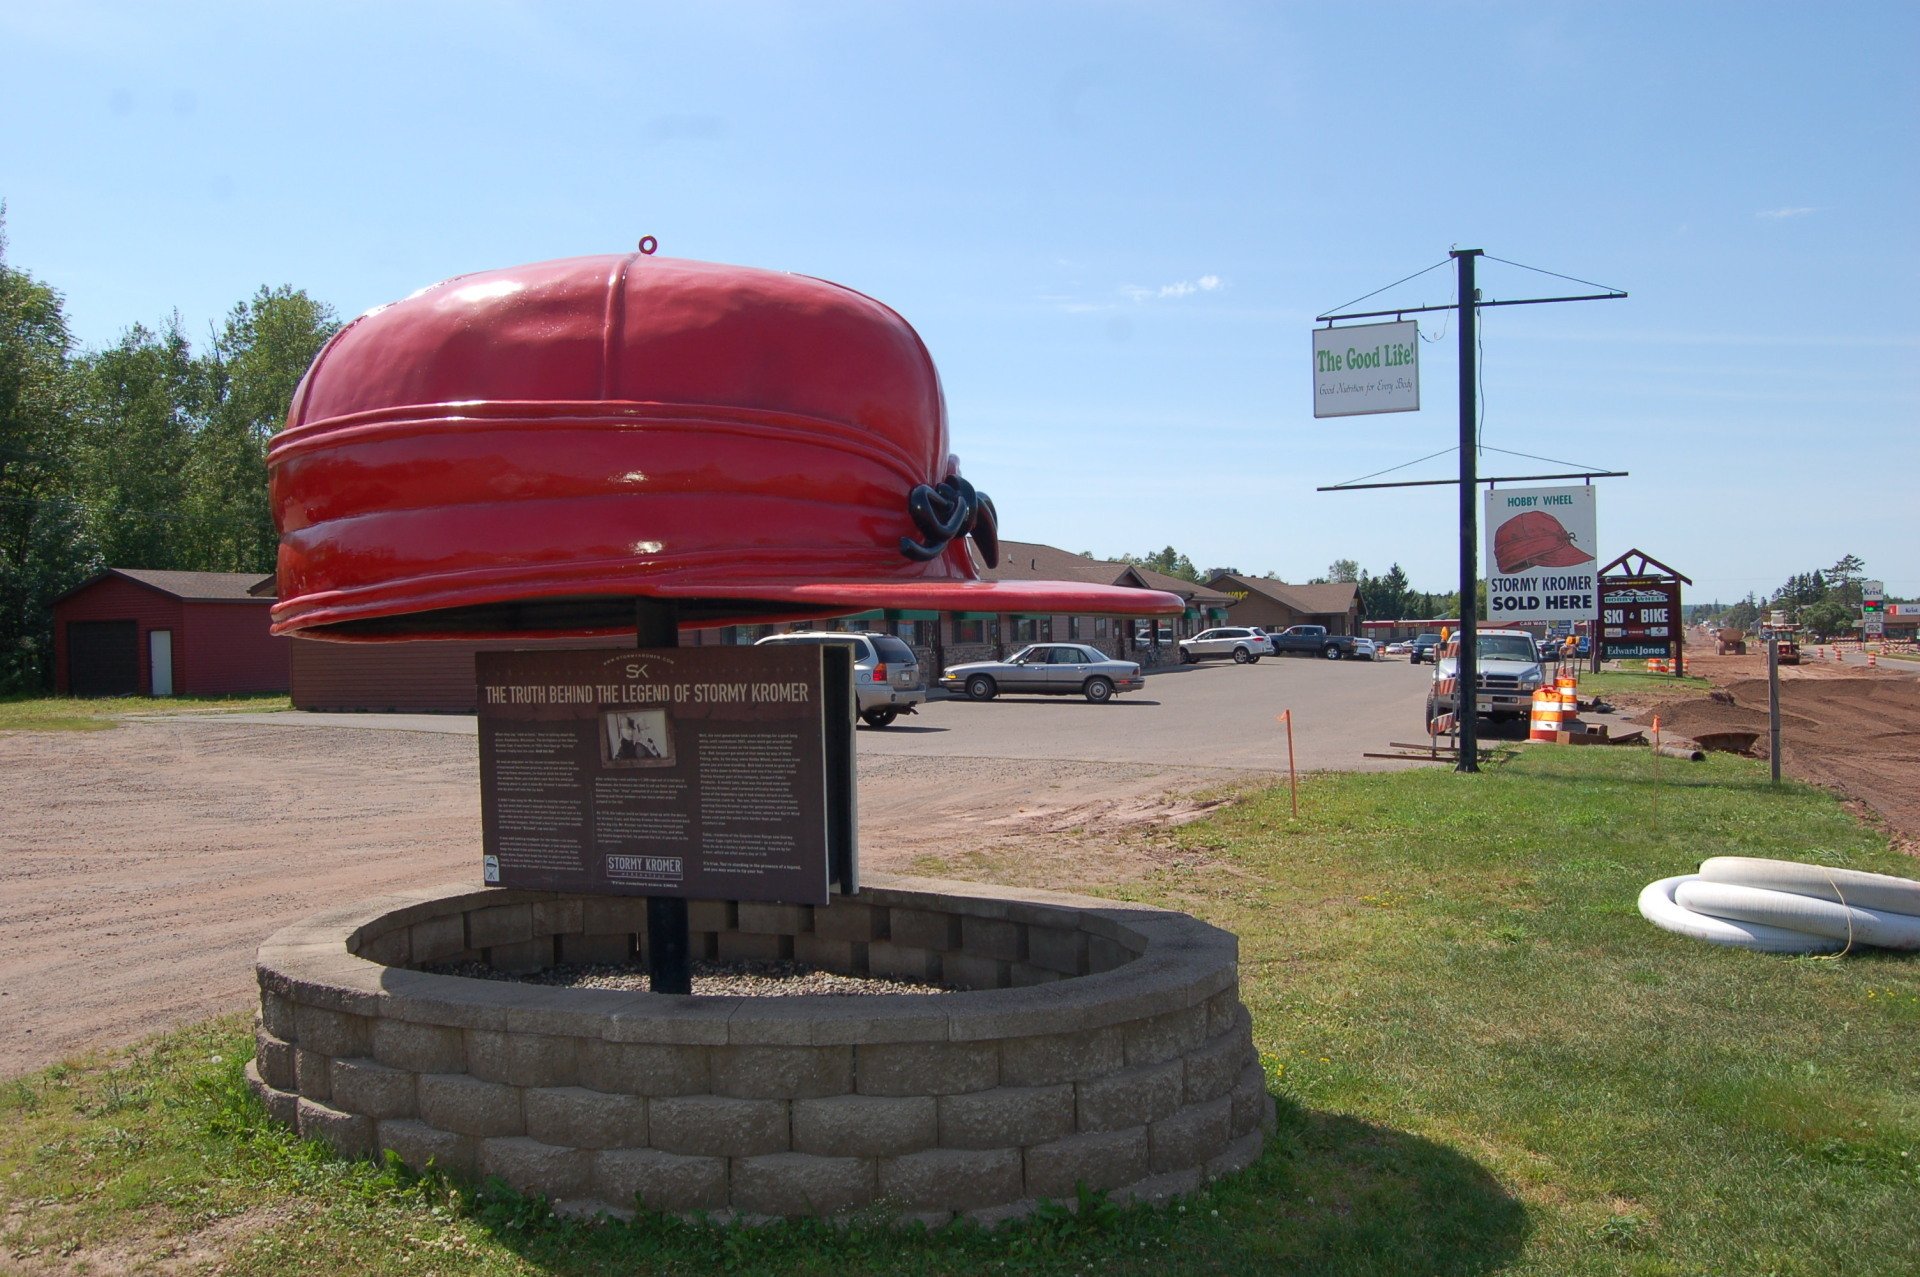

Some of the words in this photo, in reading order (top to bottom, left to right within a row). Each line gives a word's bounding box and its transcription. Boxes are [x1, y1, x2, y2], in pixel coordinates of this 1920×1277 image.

[1317, 350, 1342, 372] The
[1346, 346, 1380, 370] Good
[1384, 342, 1414, 367] Life!
[1320, 384, 1335, 395] Good
[1336, 383, 1364, 394] Nutrition
[1365, 383, 1374, 396] for
[1507, 496, 1539, 507] HOBBY
[1543, 495, 1573, 505] WHEEL
[1491, 577, 1539, 592] STORMY
[1542, 576, 1592, 591] KROMER
[1492, 596, 1540, 611] SOLD
[1545, 595, 1592, 609] HERE
[1604, 609, 1623, 624] SKI
[1641, 608, 1668, 623] BIKE
[485, 686, 507, 704] THE
[509, 685, 546, 704] TRUTH
[549, 685, 593, 704] BEHIND
[596, 685, 619, 703] THE
[622, 684, 670, 703] LEGEND
[674, 684, 690, 702] OF
[694, 683, 747, 702] STORMY
[751, 682, 809, 702] KROMER
[608, 857, 642, 870] STORMY
[645, 858, 681, 872] KROMER
